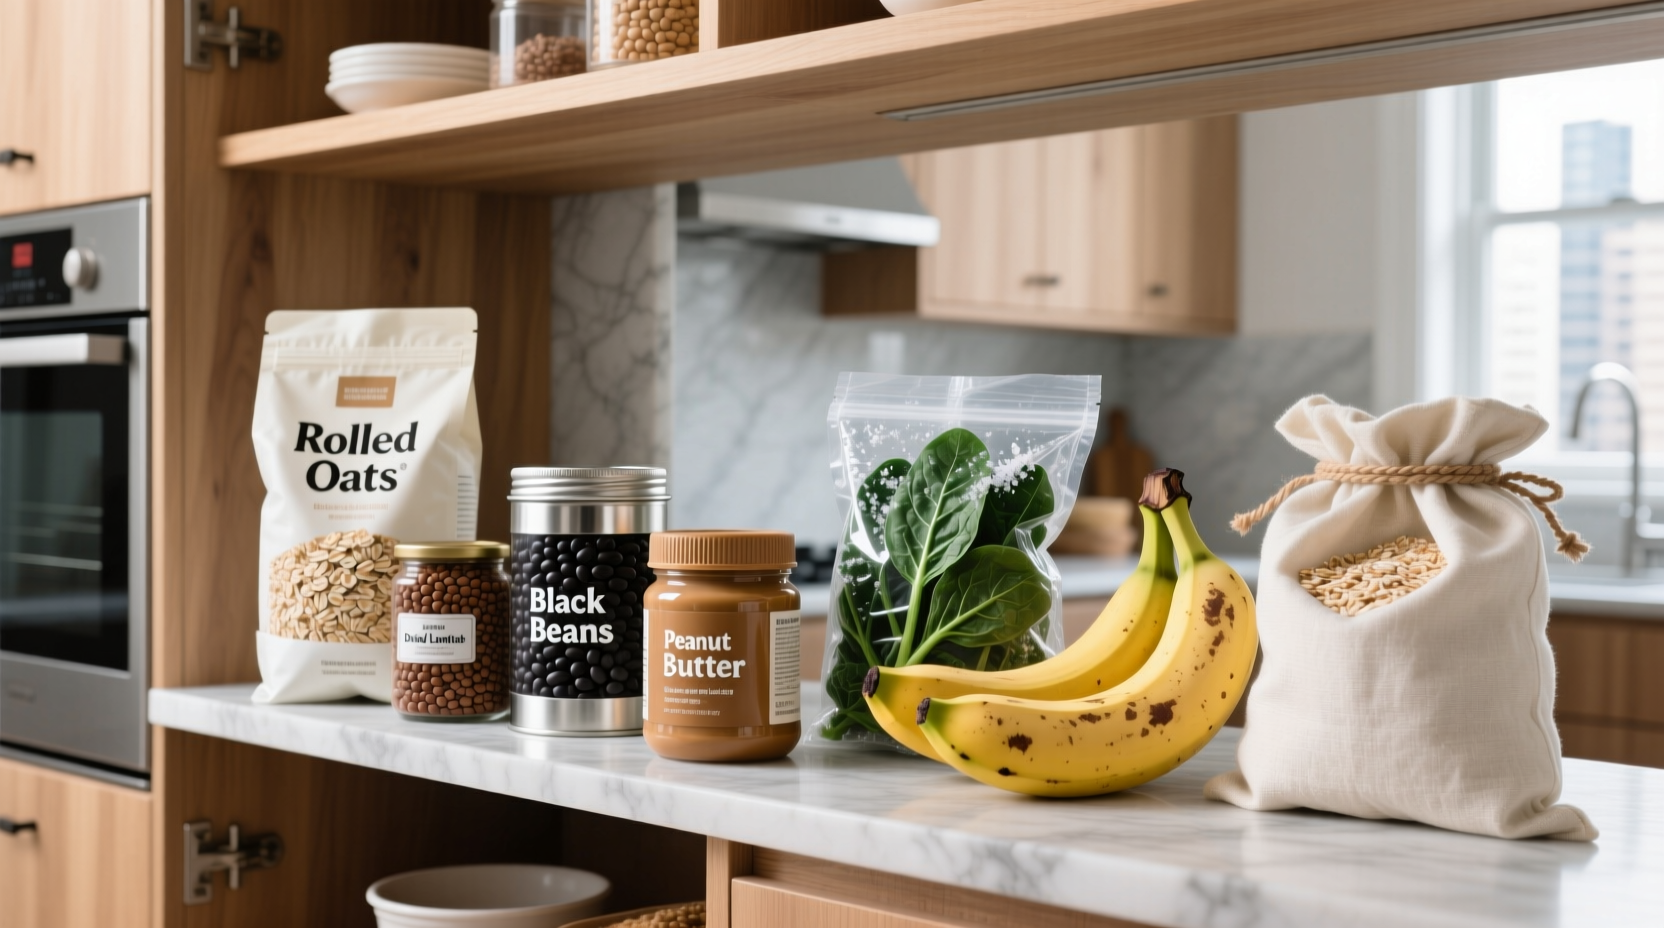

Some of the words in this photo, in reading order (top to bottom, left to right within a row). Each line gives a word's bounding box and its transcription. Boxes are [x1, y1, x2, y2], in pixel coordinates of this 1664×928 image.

[294, 420, 418, 455] Rolled
[530, 586, 607, 614] Black
[530, 616, 614, 644] Beans
[664, 629, 732, 651] Peanut
[663, 652, 746, 678] Butter
